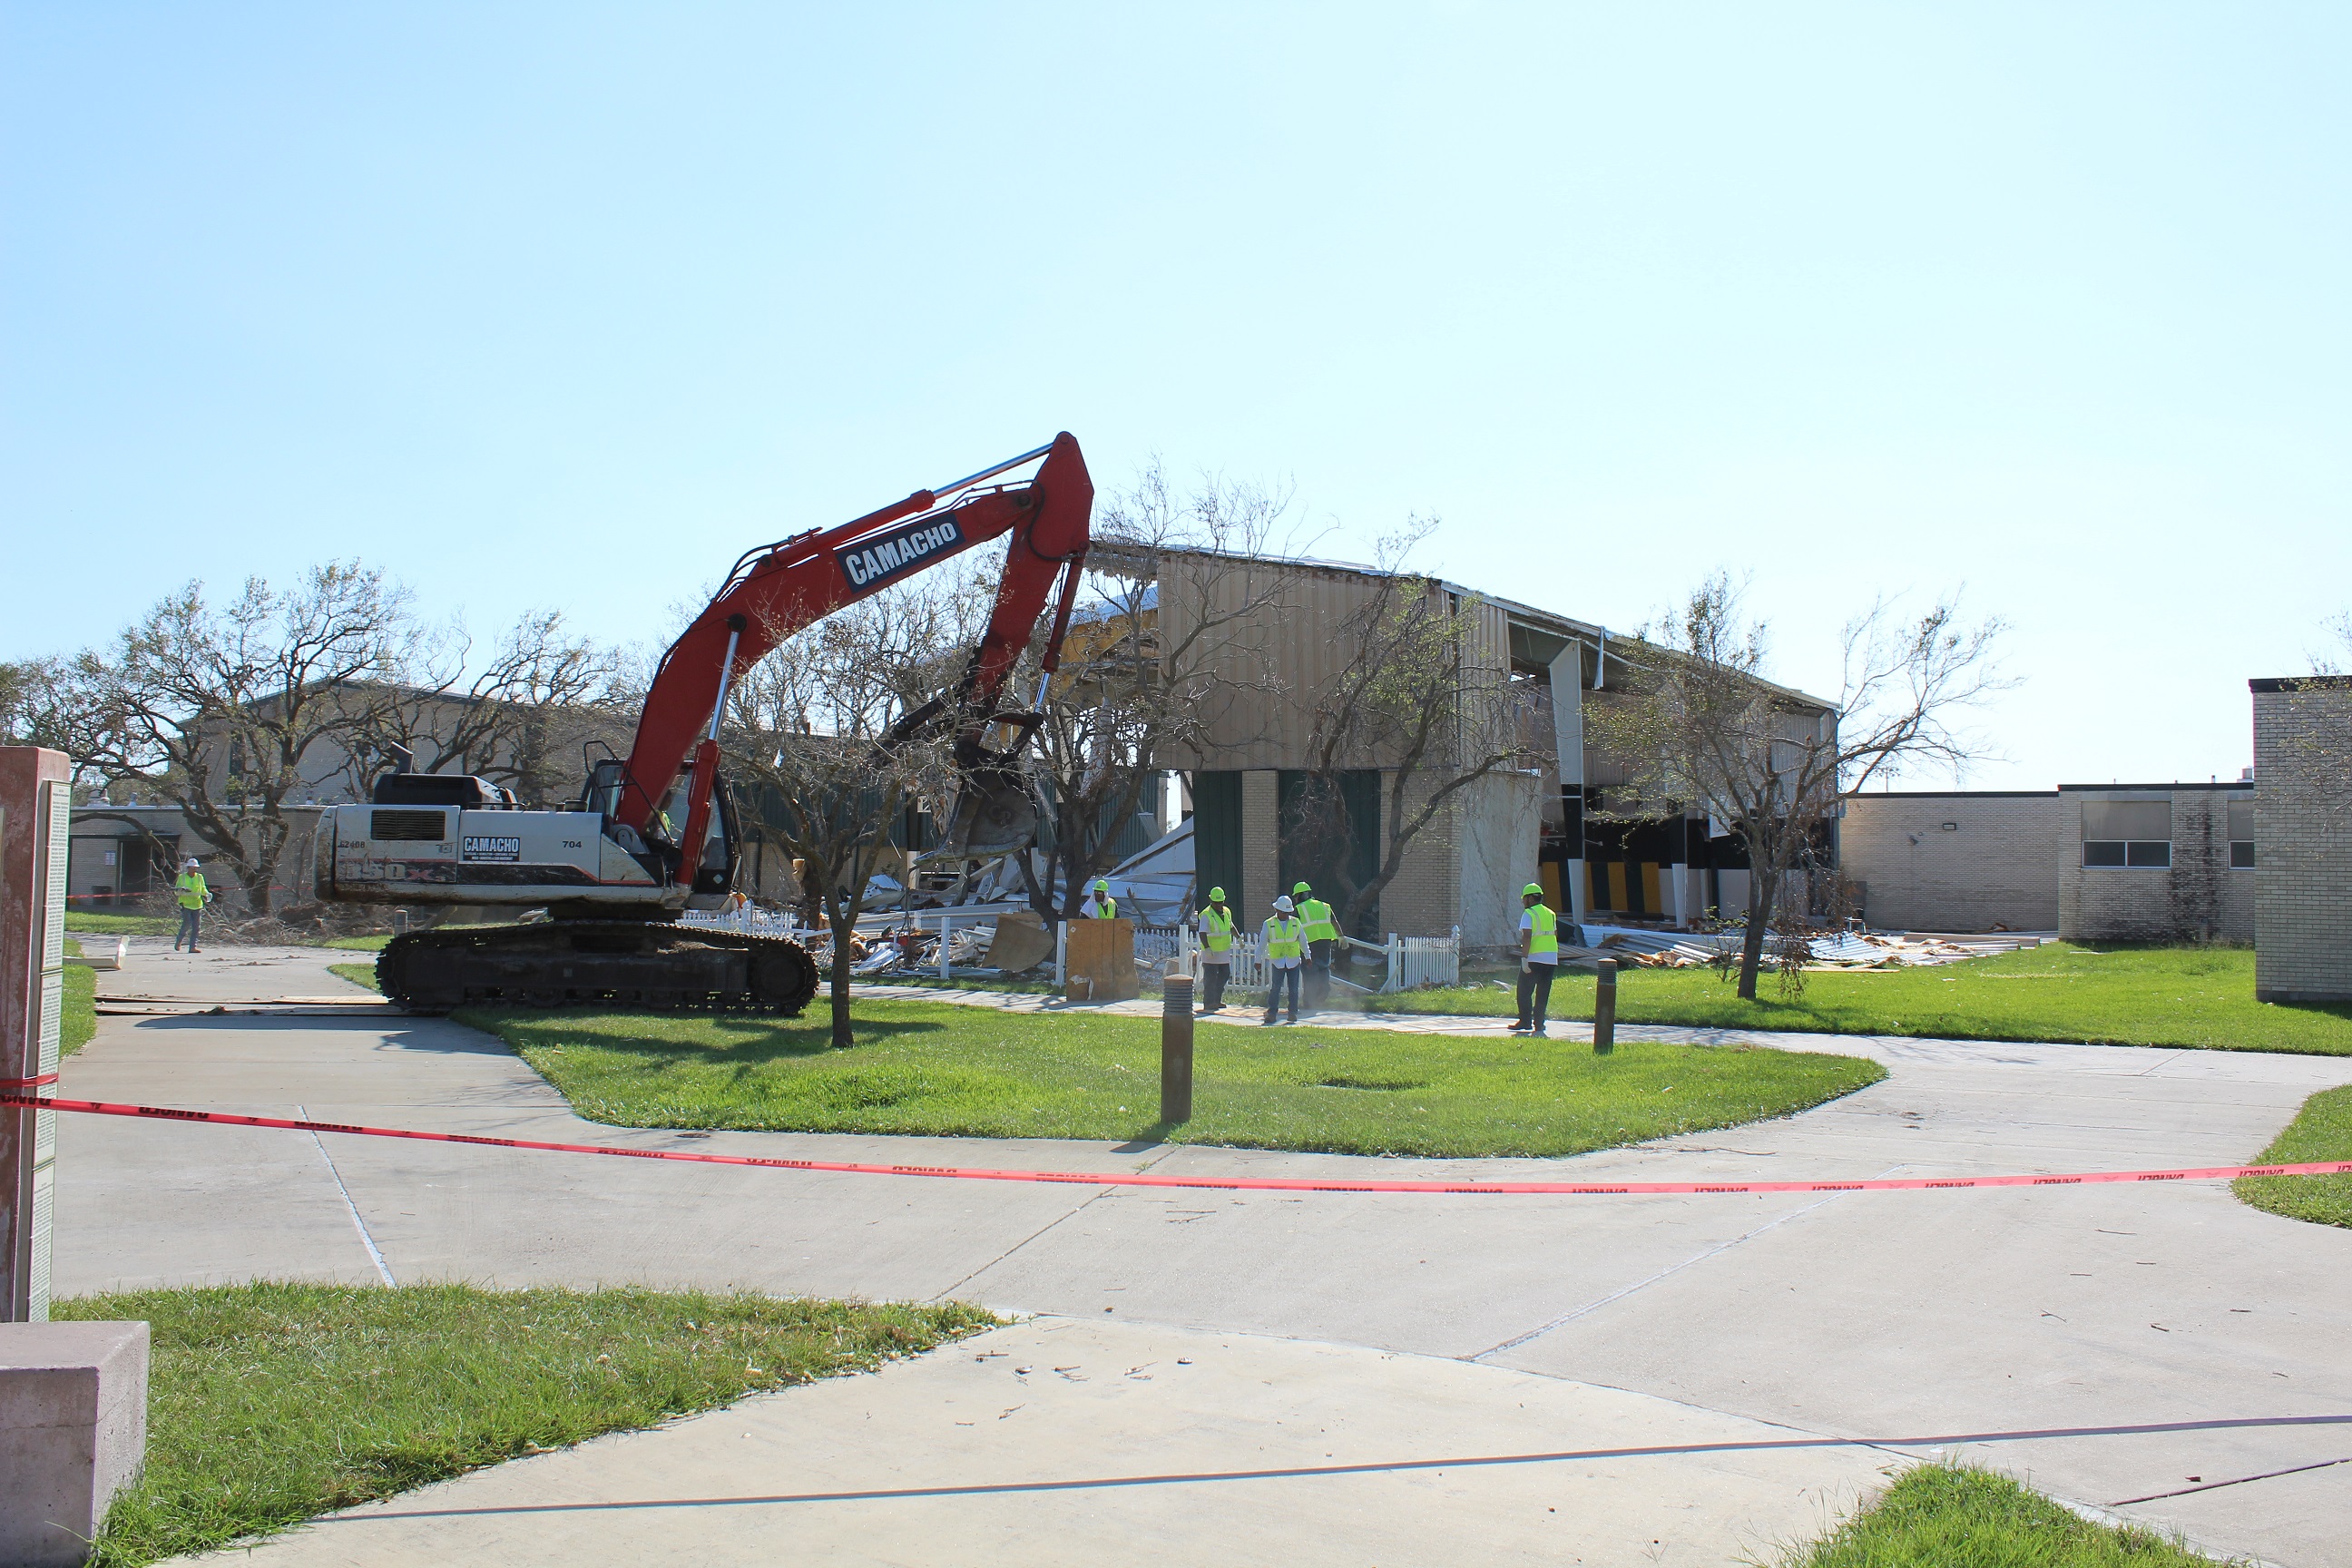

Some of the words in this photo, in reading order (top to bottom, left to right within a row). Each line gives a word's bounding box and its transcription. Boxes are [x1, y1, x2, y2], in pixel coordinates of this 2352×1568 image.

[846, 522, 957, 585] CAMACHO
[465, 838, 519, 852] CAMACHO
[563, 840, 583, 848] 704
